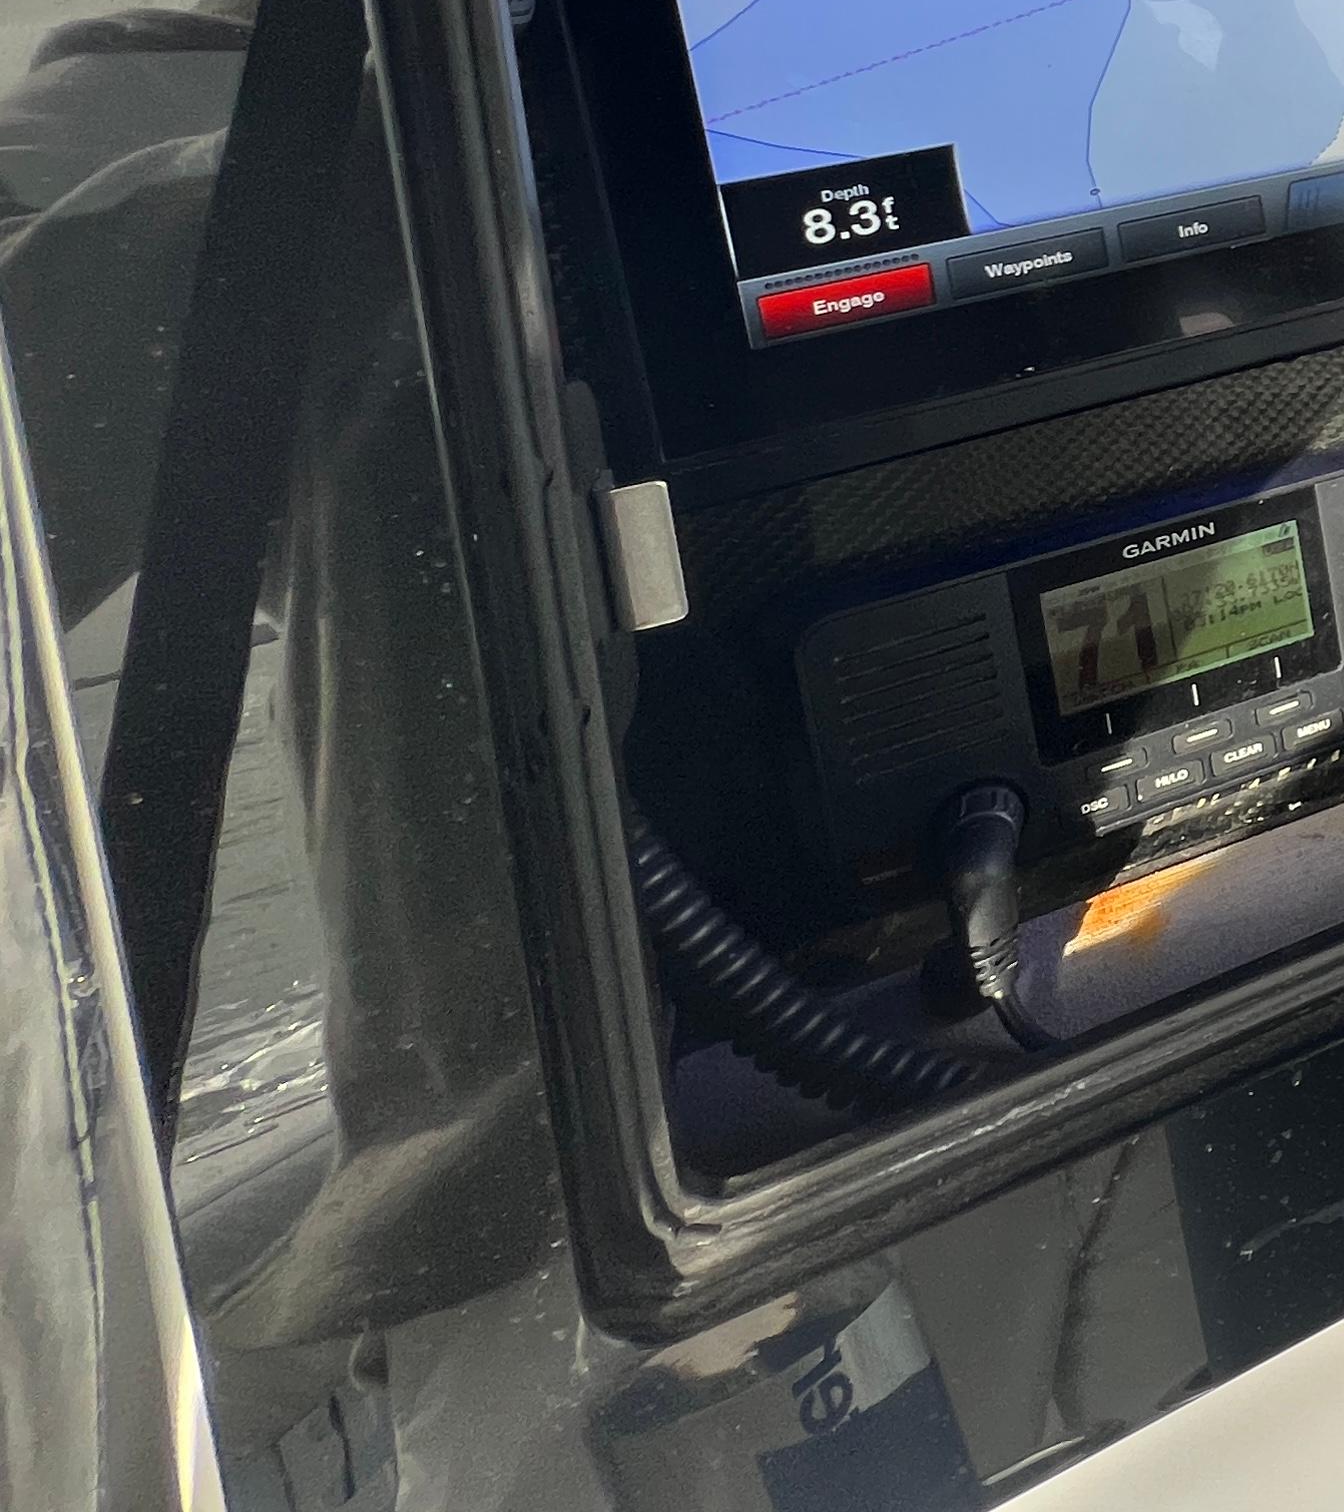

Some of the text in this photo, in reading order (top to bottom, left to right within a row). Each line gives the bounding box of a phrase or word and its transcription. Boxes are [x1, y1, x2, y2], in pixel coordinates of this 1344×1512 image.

[820, 183, 870, 204] Depth
[803, 199, 882, 246] 8.3
[812, 288, 886, 316] Engage
[984, 250, 1074, 280] Waypoints
[1178, 219, 1209, 239] Info
[1122, 521, 1215, 559] GARMIN
[1297, 718, 1331, 738] MENU
[1223, 742, 1263, 763] CLEAR
[1080, 797, 1109, 815] DSC
